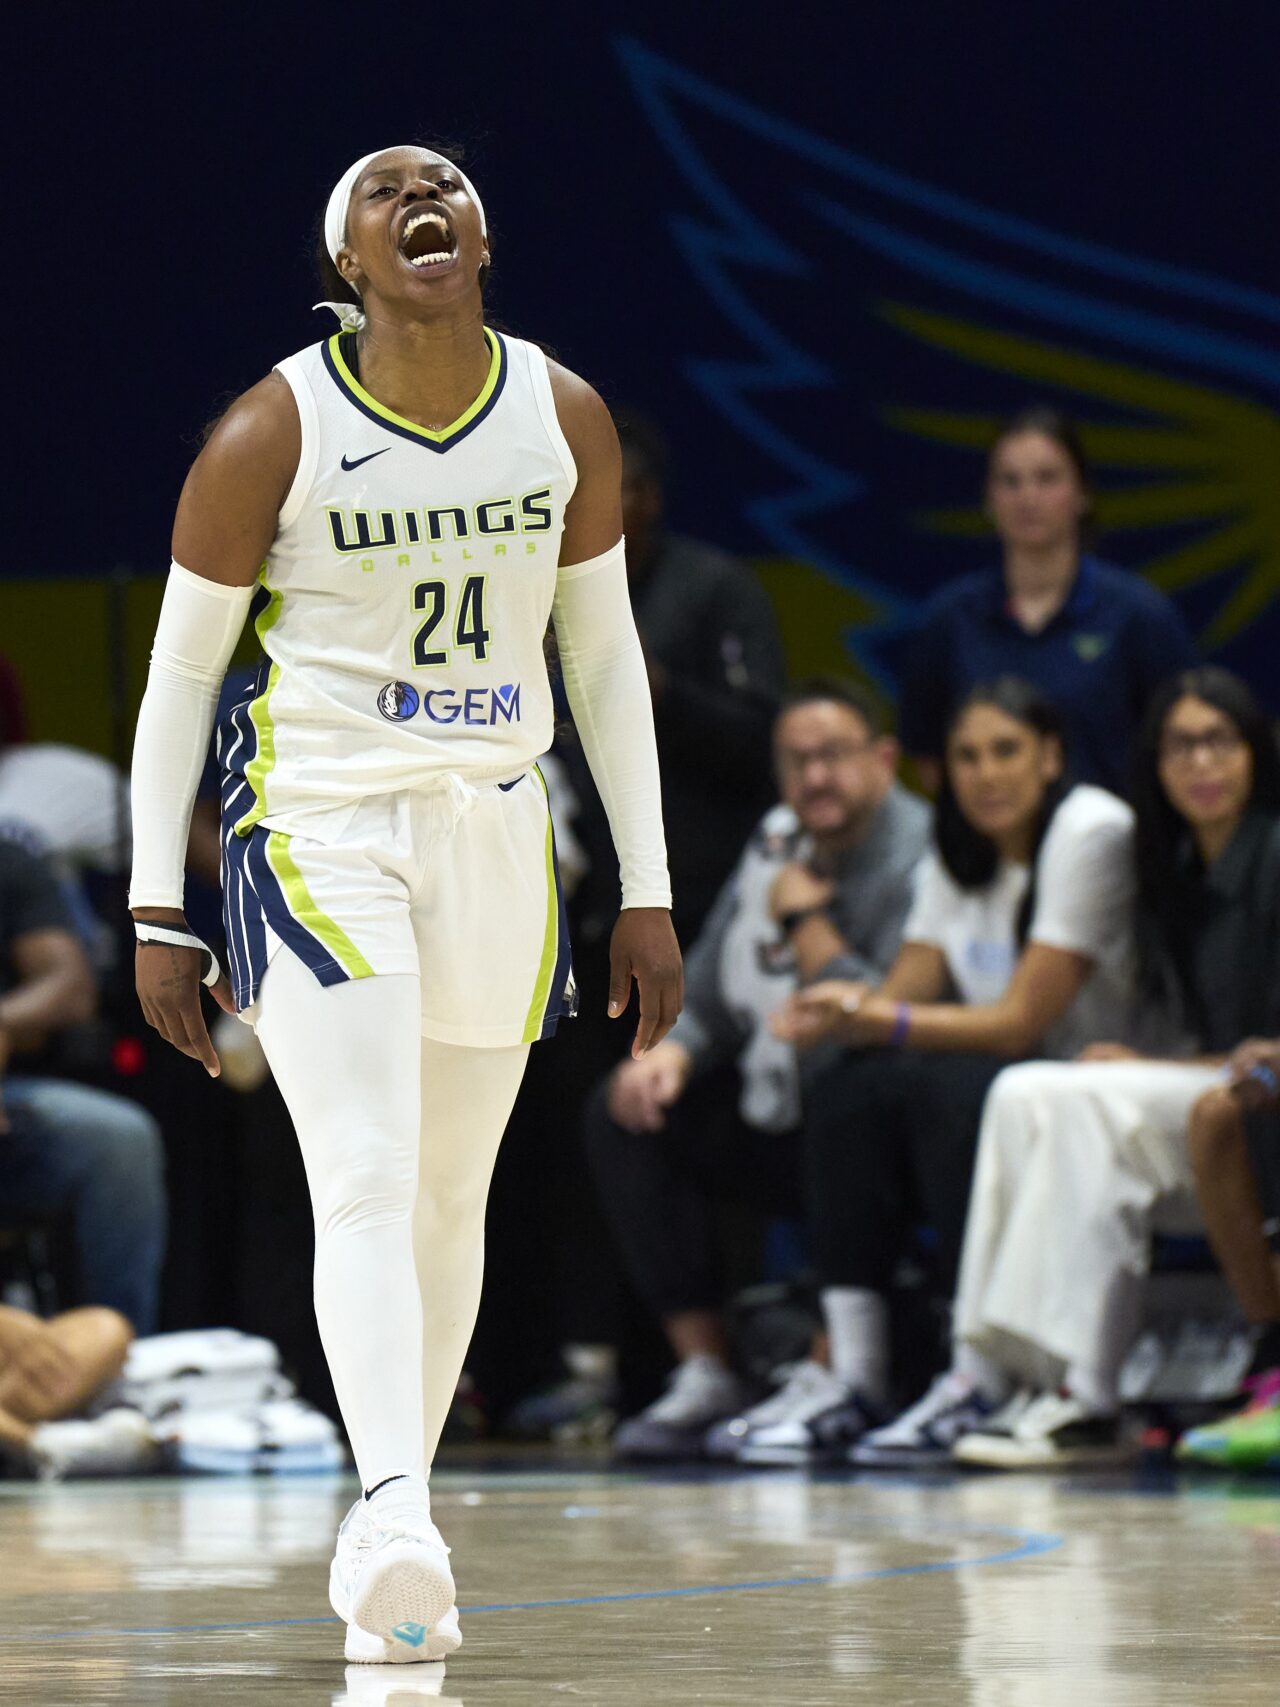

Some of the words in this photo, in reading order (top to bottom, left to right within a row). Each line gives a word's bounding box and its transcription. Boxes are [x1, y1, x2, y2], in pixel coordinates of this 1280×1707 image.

[324, 485, 552, 555] WINGS
[361, 541, 536, 572] DALLAS
[410, 572, 493, 668] 24
[424, 681, 521, 726] GEM
